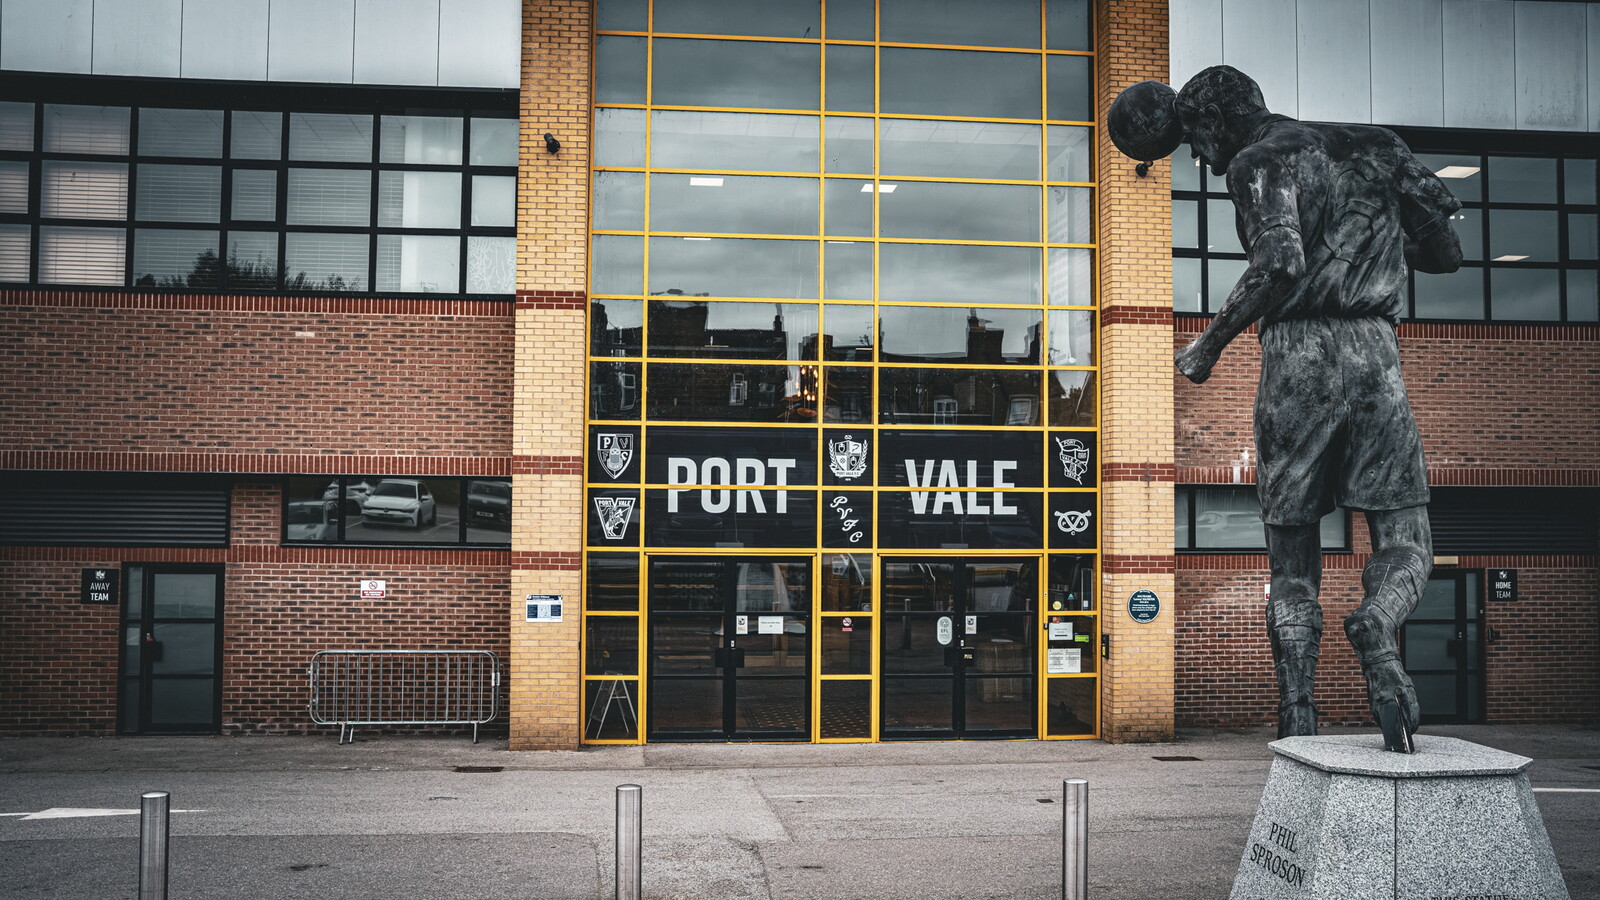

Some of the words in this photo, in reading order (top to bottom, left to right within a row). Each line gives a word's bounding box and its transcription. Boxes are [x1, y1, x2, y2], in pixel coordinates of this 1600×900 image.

[668, 457, 796, 513] PORT
[904, 459, 1018, 515] VALE
[90, 582, 110, 590] AWAY
[1495, 581, 1511, 589] HOME
[90, 592, 109, 601] TEAM
[1269, 822, 1297, 853] PHIL
[1250, 843, 1306, 888] SPROSON
